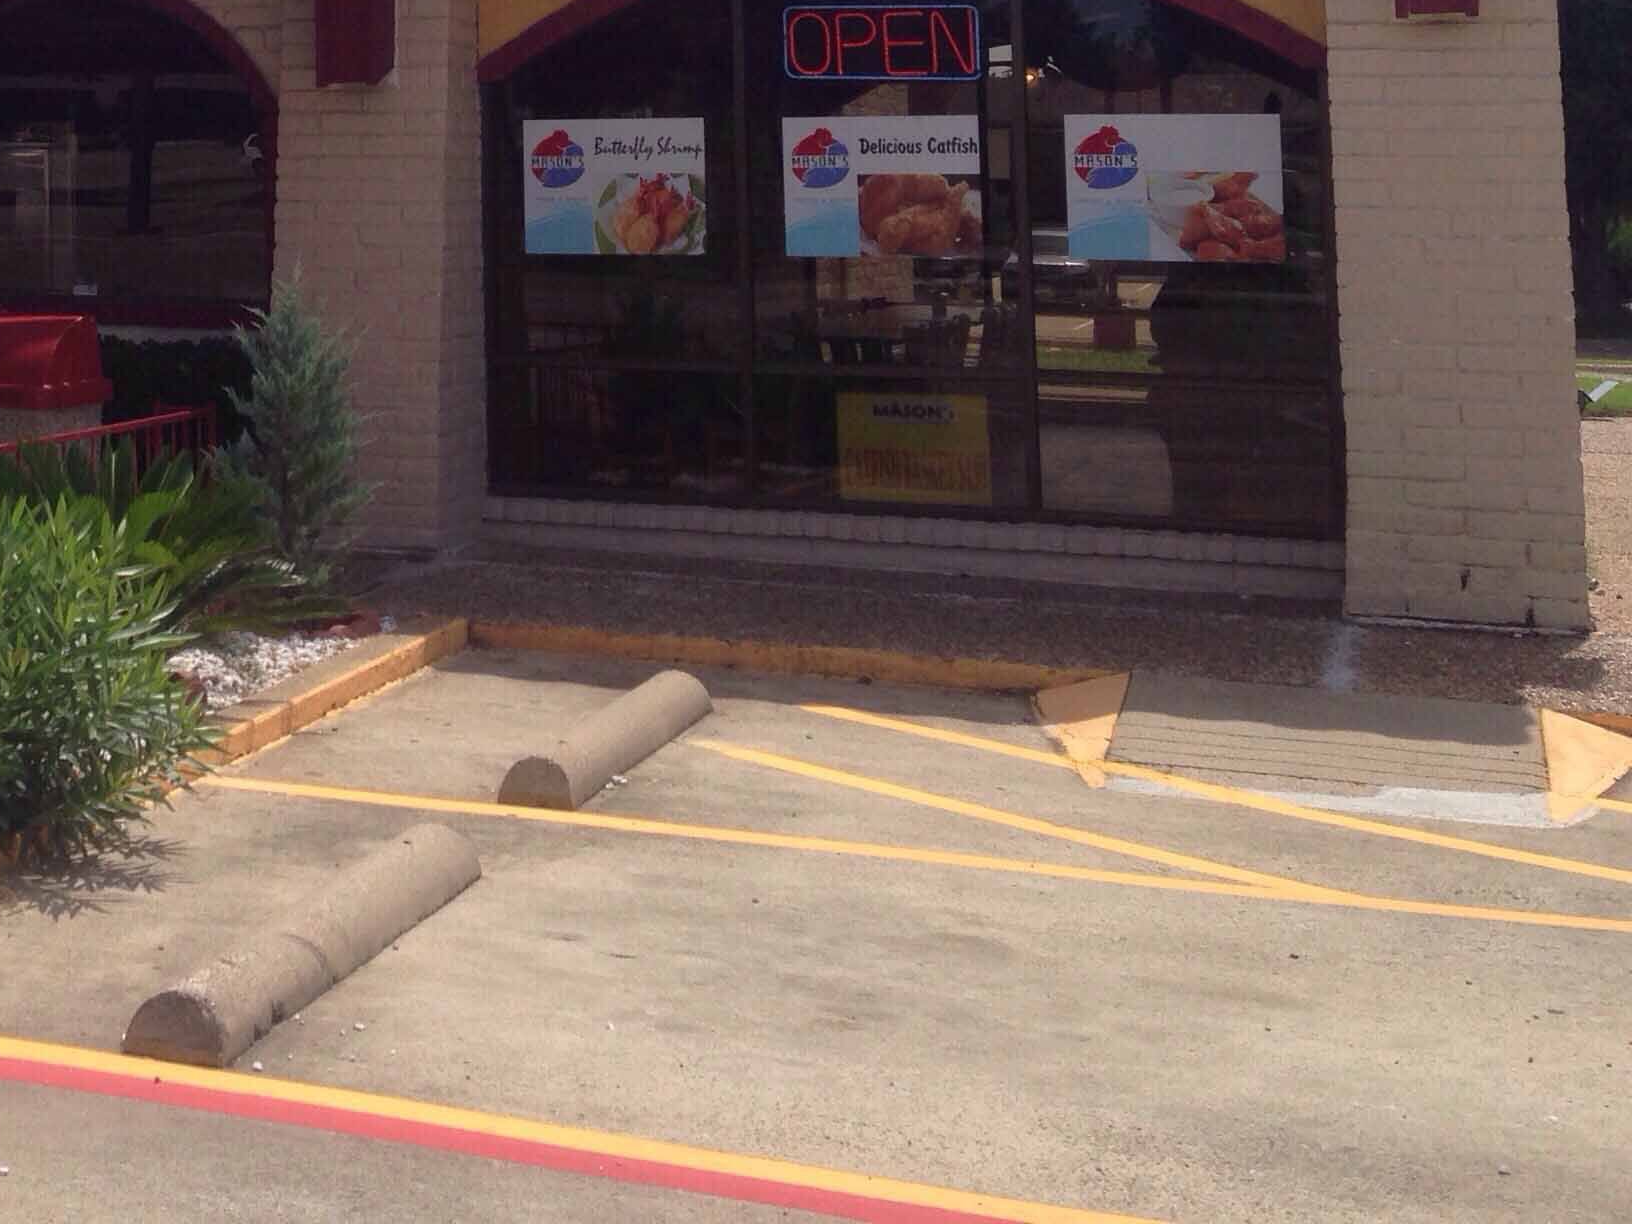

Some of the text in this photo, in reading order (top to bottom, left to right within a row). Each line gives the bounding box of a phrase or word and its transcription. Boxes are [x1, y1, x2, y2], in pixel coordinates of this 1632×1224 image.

[789, 8, 975, 75] OPEN
[594, 136, 704, 160] Butterfly Shrimp
[859, 136, 978, 155] Delicious Catfish
[531, 156, 585, 168] MASON'S
[792, 156, 849, 168] MASON'S
[1073, 154, 1138, 168] MASON'S
